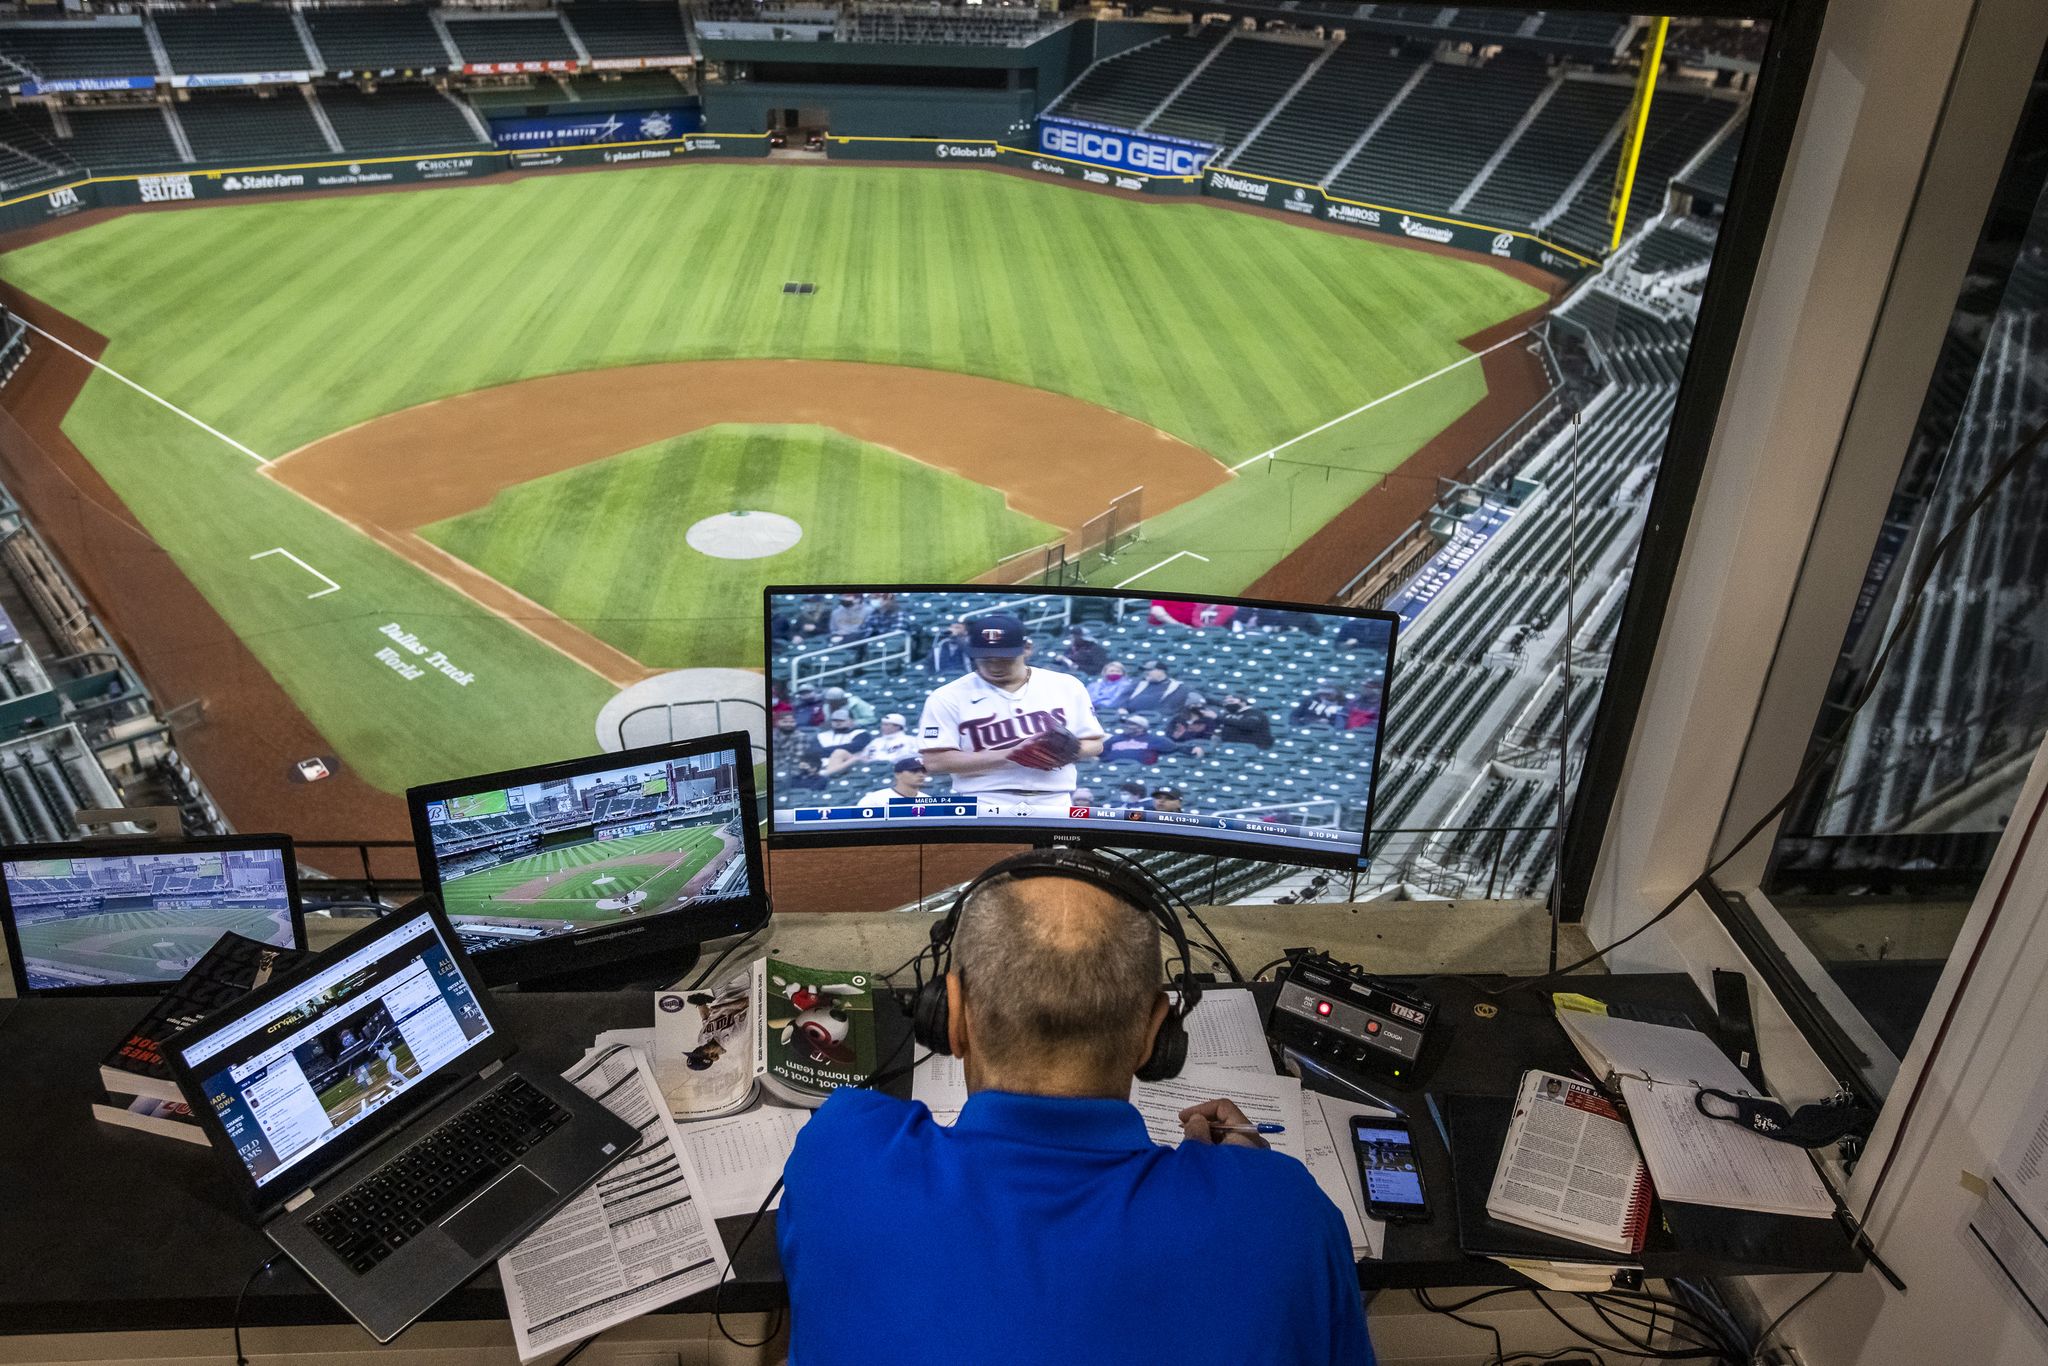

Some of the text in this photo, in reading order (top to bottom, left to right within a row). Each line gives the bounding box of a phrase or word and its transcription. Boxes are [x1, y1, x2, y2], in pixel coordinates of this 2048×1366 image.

[499, 127, 597, 142] LOCKHEED MARTIN
[1042, 126, 1122, 162] GEICO
[612, 149, 671, 163] planet fitness
[950, 146, 997, 158] Globe Life
[1225, 176, 1269, 196] National
[48, 187, 79, 209] UTA
[139, 183, 195, 203] SELTZER
[378, 622, 475, 687] Dallas Truck
[374, 646, 425, 681] World
[958, 707, 1069, 753] Twins
[862, 808, 874, 818] 0
[954, 806, 966, 816] 0
[1097, 810, 1117, 818] MLB
[1158, 815, 1174, 823] BAL
[1246, 823, 1262, 832] SEA
[265, 1019, 287, 1035] CITY
[1383, 1030, 1403, 1042] COUGH
[773, 1065, 789, 1077] for
[786, 1060, 815, 1076] team
[791, 1071, 814, 1084] root
[817, 1071, 850, 1082] home
[1570, 1084, 1590, 1095] DANE
